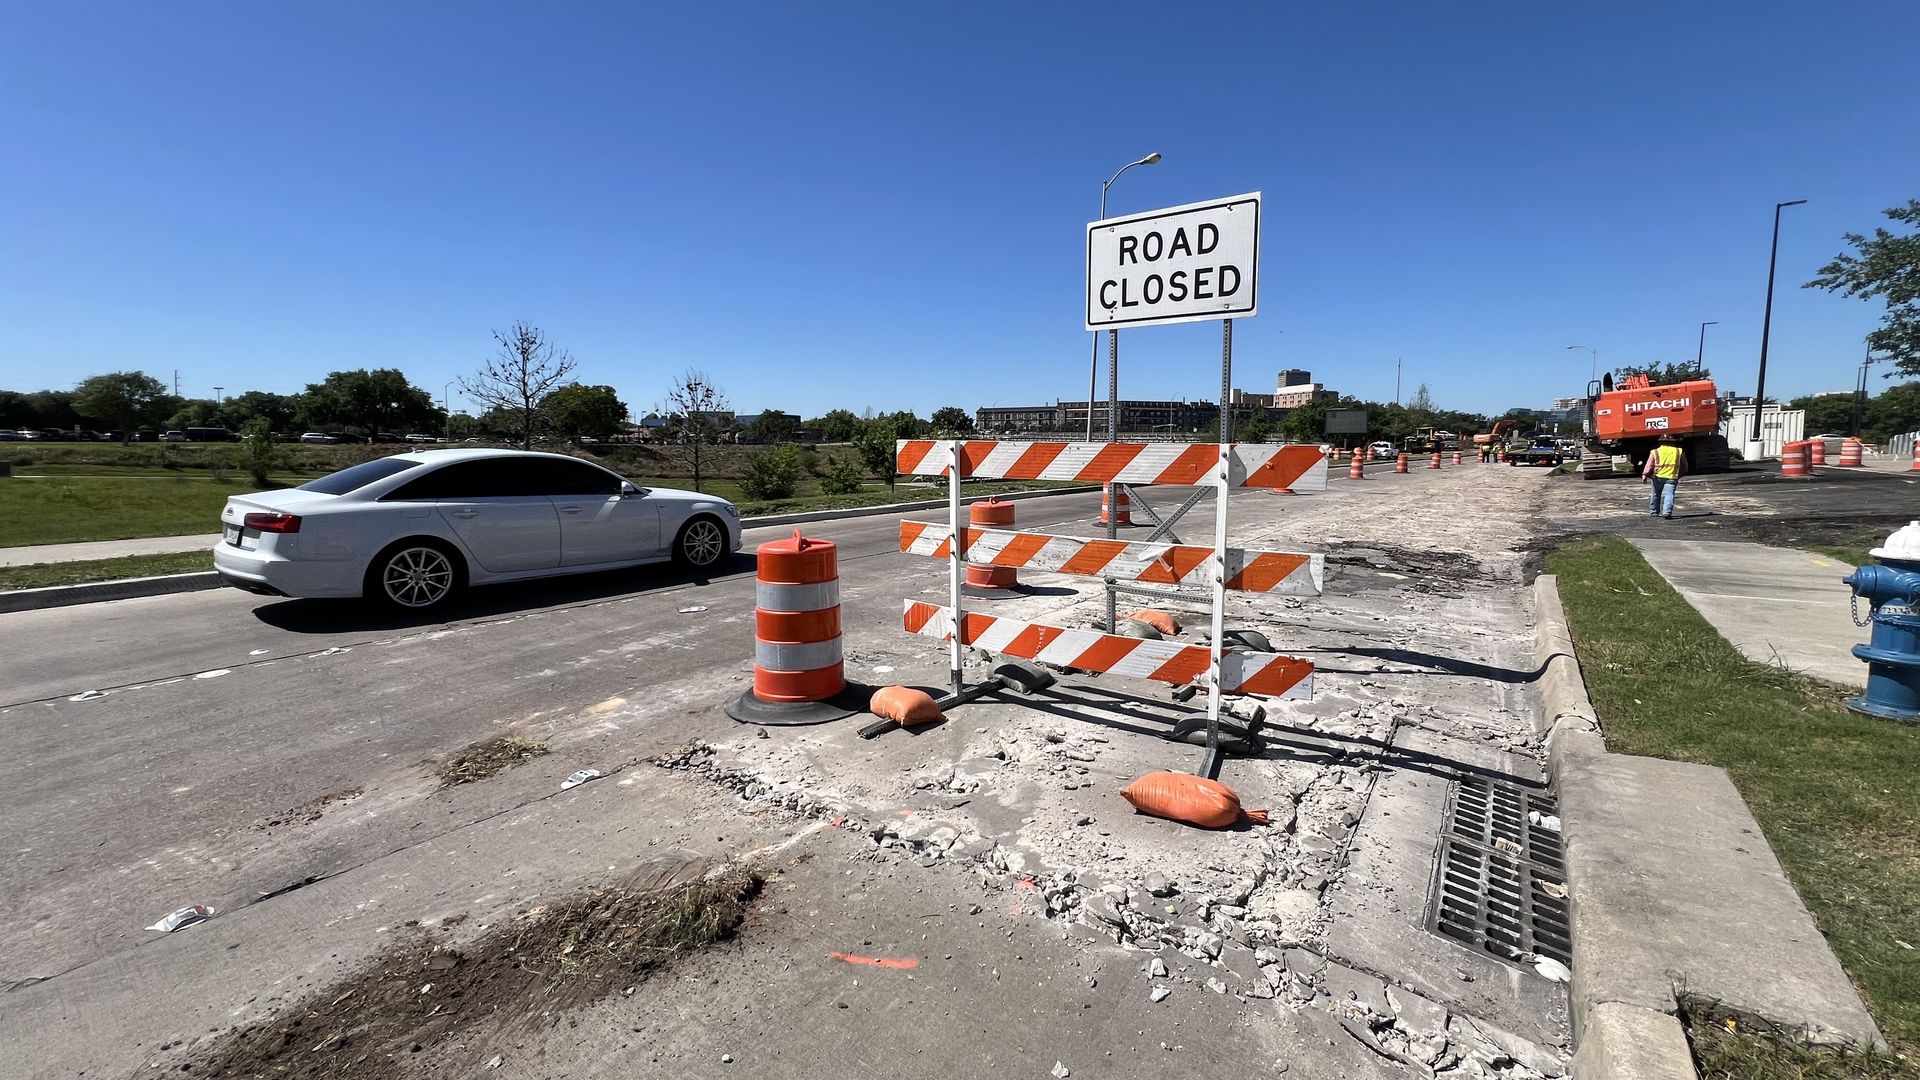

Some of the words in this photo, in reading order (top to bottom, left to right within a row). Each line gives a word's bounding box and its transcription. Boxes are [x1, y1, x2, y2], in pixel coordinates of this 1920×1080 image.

[1119, 223, 1220, 266] ROAD
[1099, 264, 1241, 310] CLOSED
[1624, 397, 1690, 413] HITACHI
